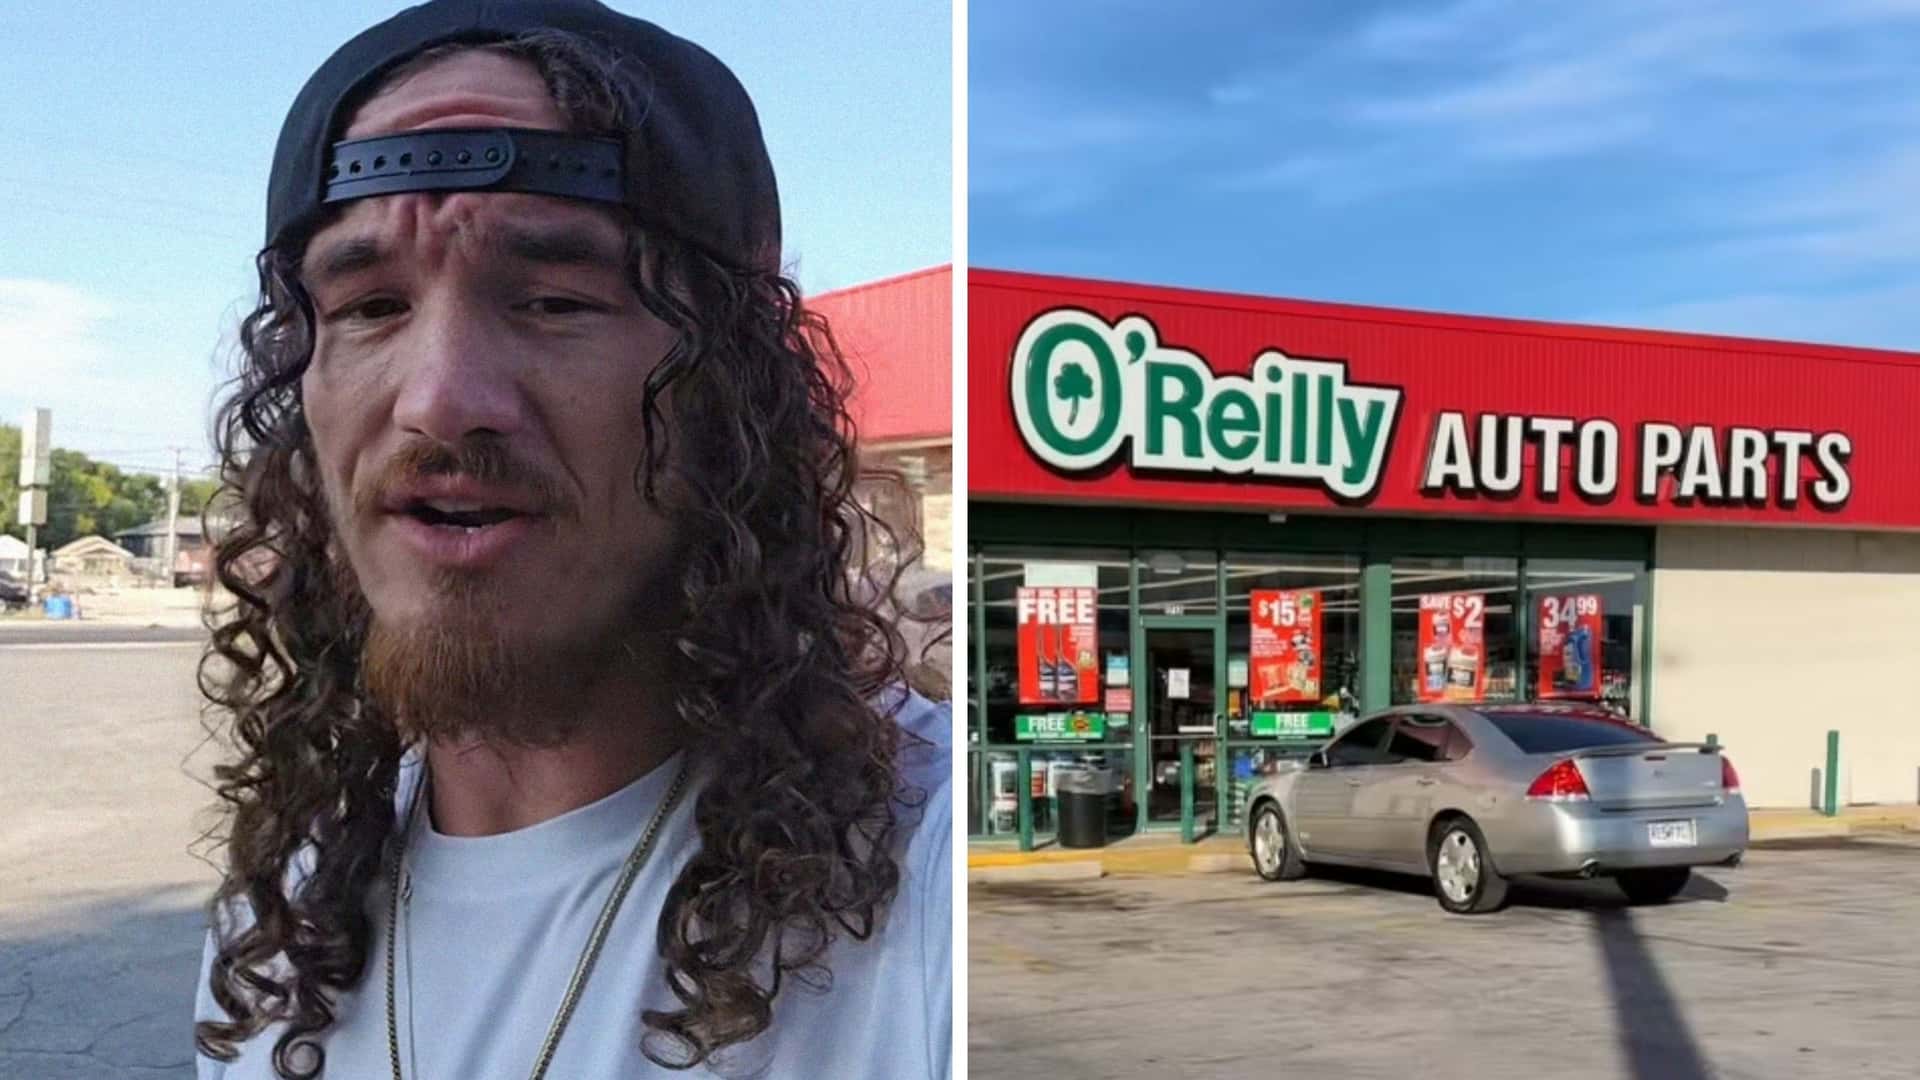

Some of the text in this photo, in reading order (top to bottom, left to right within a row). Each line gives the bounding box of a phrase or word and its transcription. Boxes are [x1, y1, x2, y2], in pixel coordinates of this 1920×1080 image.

[1021, 318, 1390, 488] O'Reilly
[1424, 411, 1852, 505] AUTO PARTS
[1018, 597, 1094, 625] FREE
[1258, 598, 1297, 627] $15
[1452, 594, 1483, 628] $2
[1028, 714, 1066, 732] FREE
